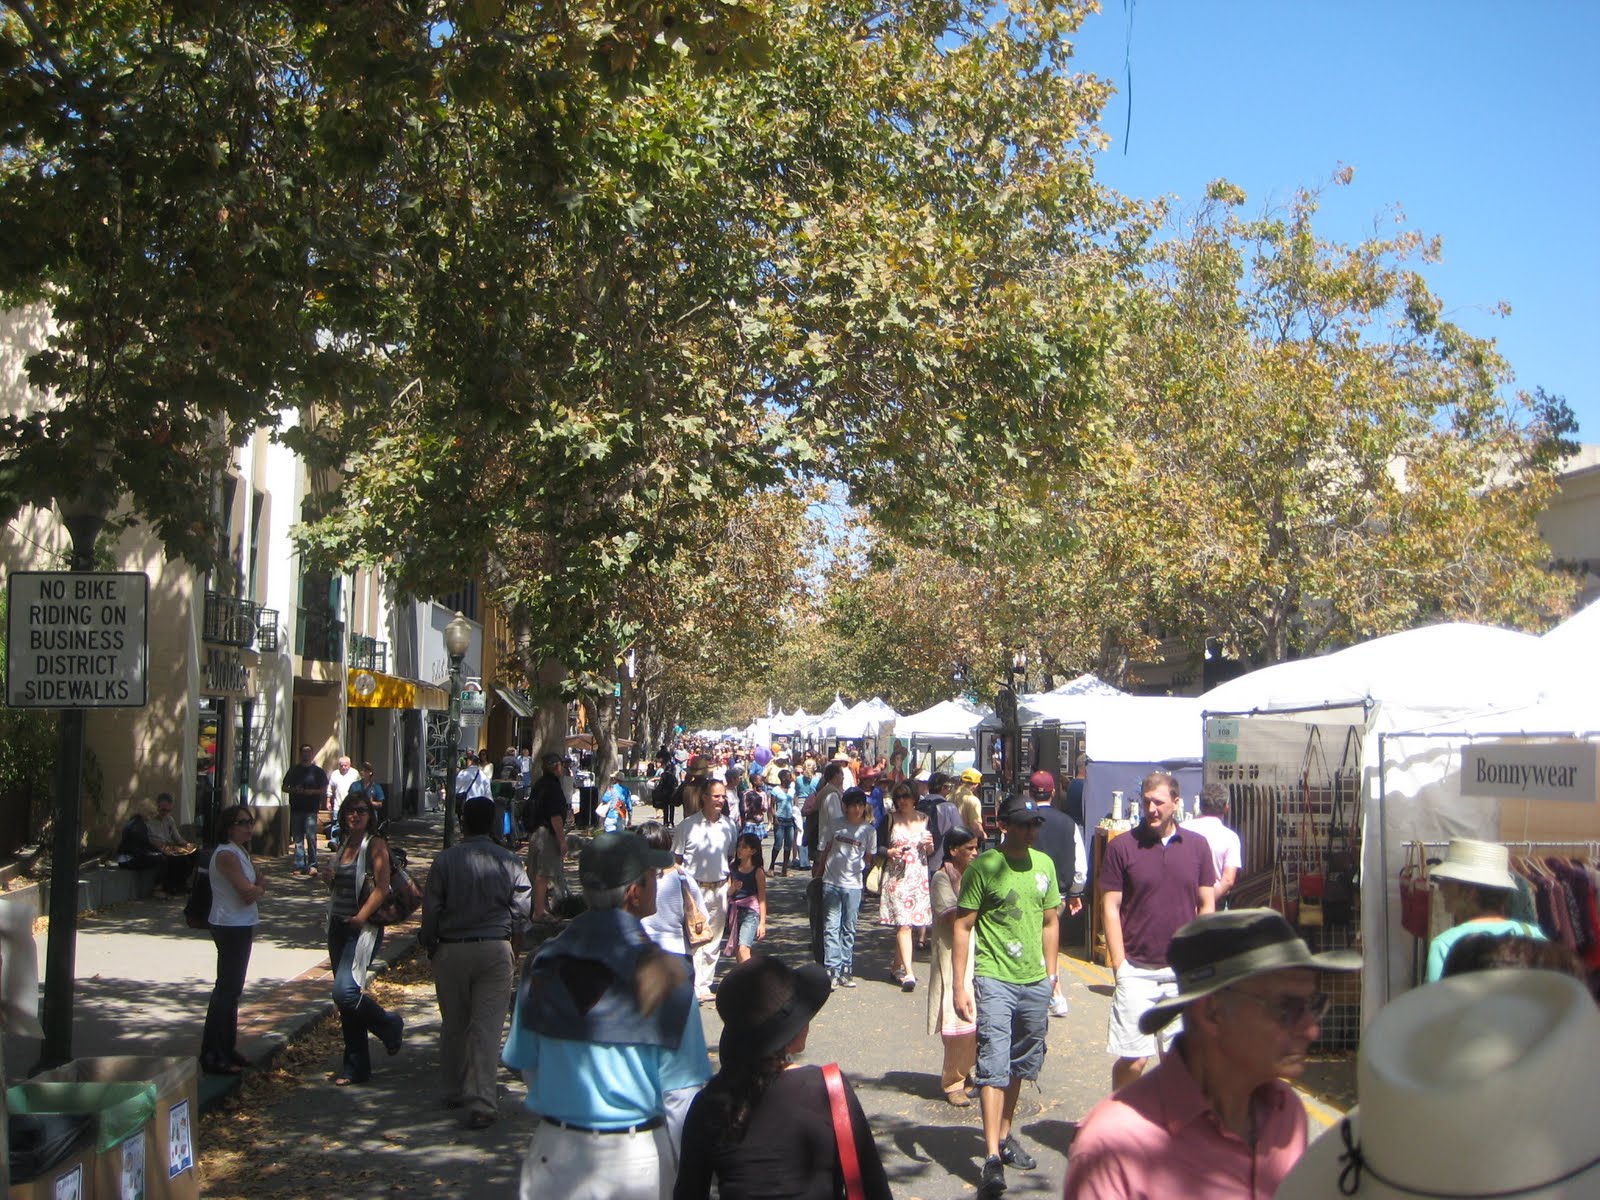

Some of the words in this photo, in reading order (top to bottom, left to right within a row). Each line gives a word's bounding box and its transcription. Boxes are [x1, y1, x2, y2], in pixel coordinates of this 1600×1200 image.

[40, 580, 65, 600] NO
[75, 580, 117, 600] BIKE
[30, 606, 92, 625] RIDING
[101, 605, 126, 625] ON
[31, 631, 124, 650] BUSINESS
[36, 655, 117, 675] DISTRICT
[25, 680, 129, 700] SIDEWALKS
[1476, 758, 1577, 791] Bonnywear
